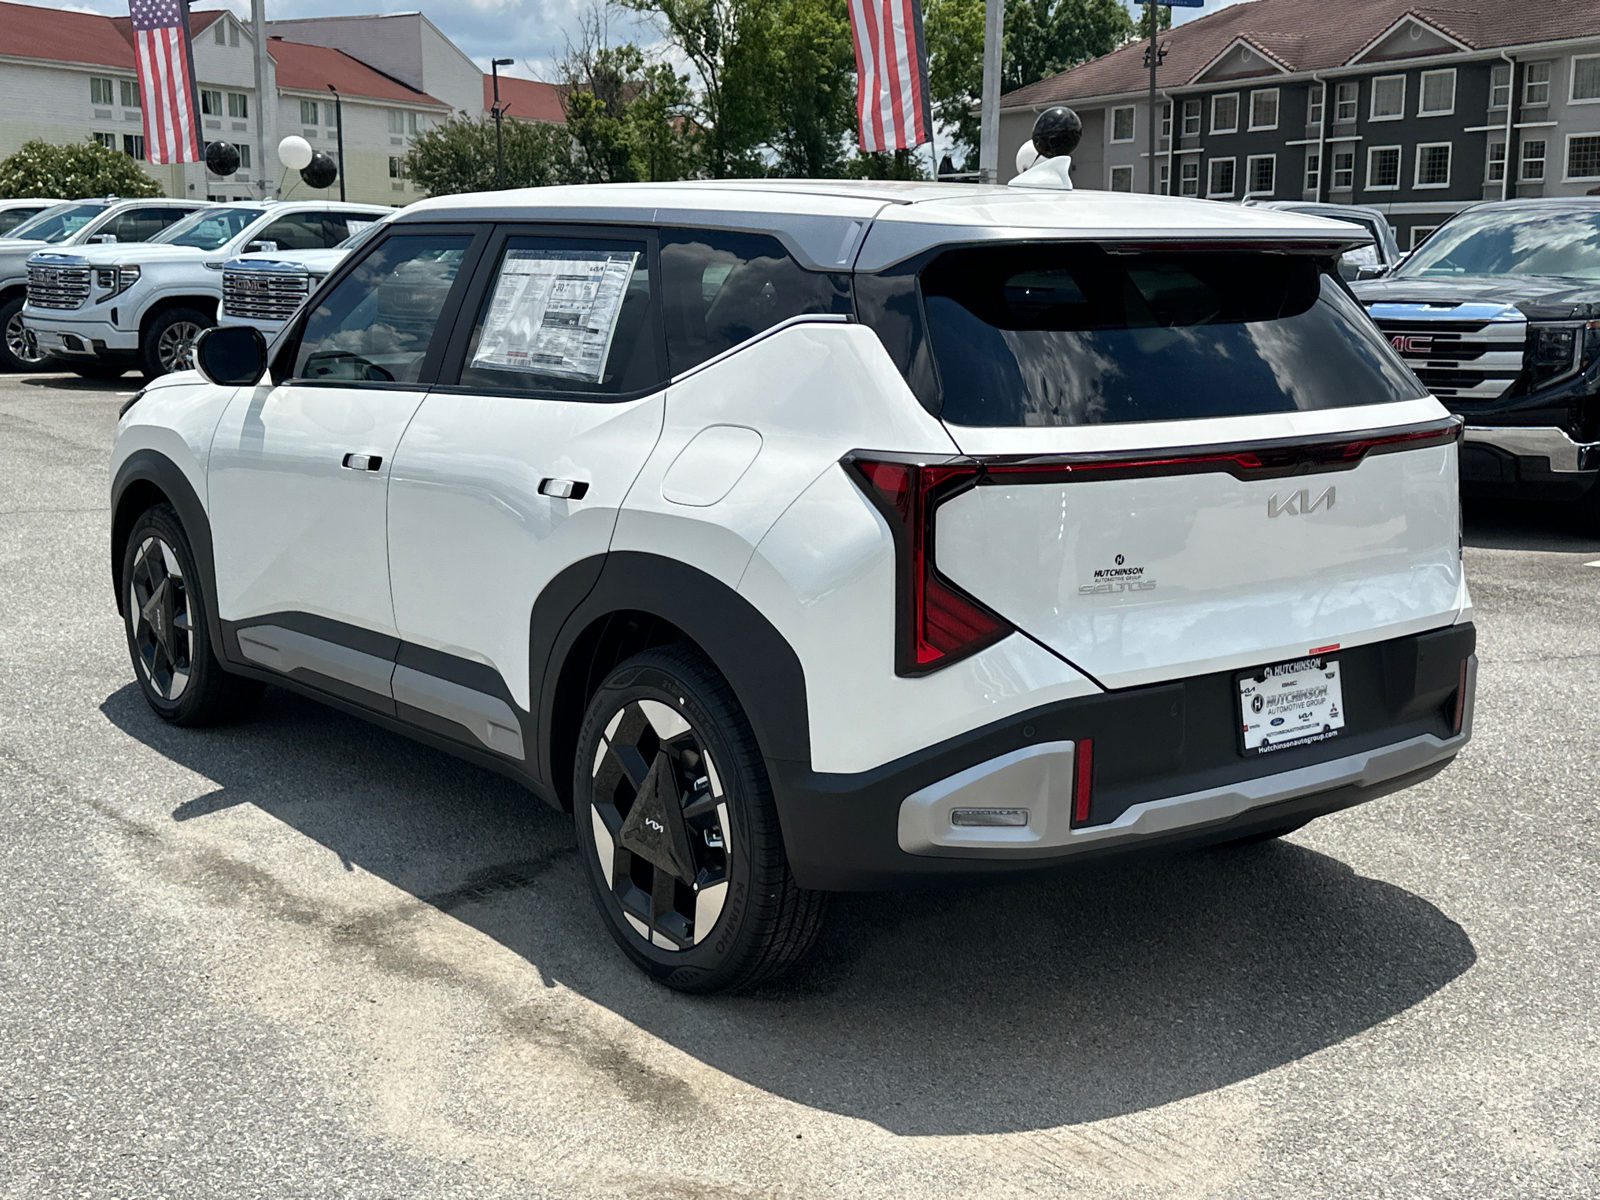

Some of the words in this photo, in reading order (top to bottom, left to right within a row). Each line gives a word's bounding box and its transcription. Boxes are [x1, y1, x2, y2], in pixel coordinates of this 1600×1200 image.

[236, 279, 268, 291] GMC
[1268, 486, 1336, 518] KIA
[1094, 566, 1144, 577] HUTCHINSON
[1078, 579, 1157, 596] SELTOS
[1274, 657, 1322, 677] HUTCHINSON
[1281, 680, 1298, 688] GMC
[1266, 684, 1328, 708] HUTCHINSON
[1268, 700, 1305, 715] AUTOMOTIVE
[1305, 697, 1327, 708] GROUP
[1258, 730, 1338, 754] Hutchinsonautogroup.com
[715, 880, 746, 956] KUMHO
